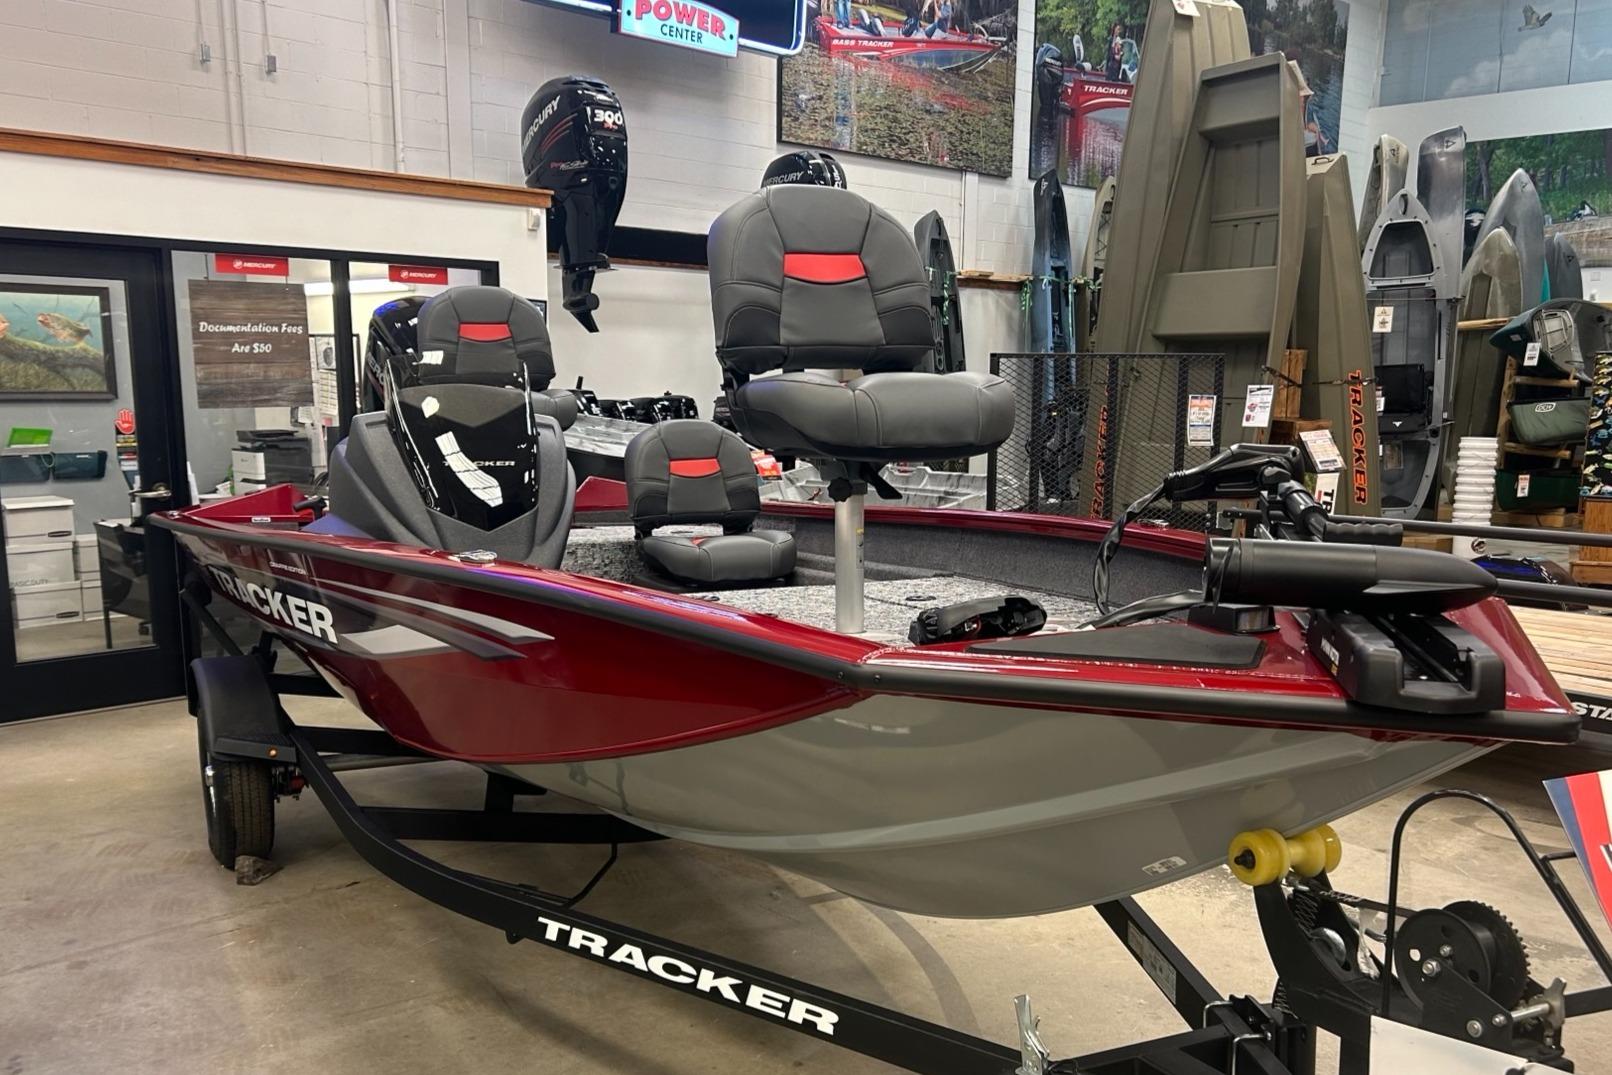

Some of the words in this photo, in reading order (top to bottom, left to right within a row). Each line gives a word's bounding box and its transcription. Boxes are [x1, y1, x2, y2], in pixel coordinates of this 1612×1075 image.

[635, 0, 727, 41] POWER
[660, 23, 703, 44] CENTER
[832, 38, 855, 46] BASS
[858, 39, 894, 48] TRACKER
[1083, 84, 1128, 96] TRACKER
[593, 108, 623, 125] 300
[243, 261, 276, 269] MERCURY
[409, 271, 437, 279] MERCURY
[199, 321, 279, 334] Documentation
[280, 323, 303, 335] Fees
[231, 342, 251, 353] Are
[252, 342, 272, 354] $50
[1348, 370, 1368, 505] TRACKER
[206, 564, 338, 644] TRACKER
[538, 916, 839, 1036] TRACKER
